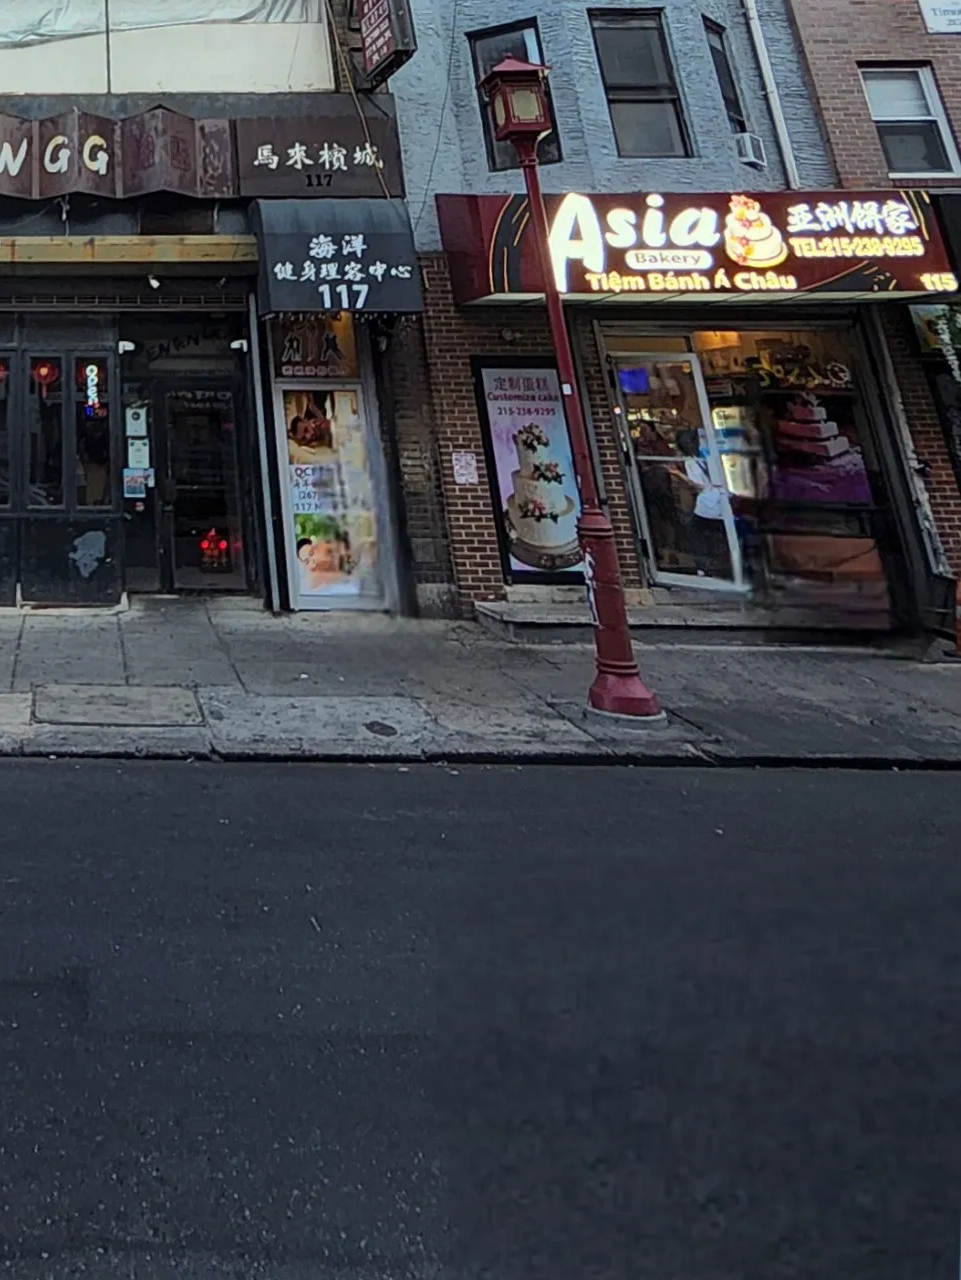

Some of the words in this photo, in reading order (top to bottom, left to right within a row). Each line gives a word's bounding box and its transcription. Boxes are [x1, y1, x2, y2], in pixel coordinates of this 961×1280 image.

[305, 174, 333, 188] 117
[309, 234, 368, 260] 海洋
[548, 193, 721, 292] Asia
[634, 251, 701, 267] Bakery
[273, 260, 412, 282] 健身理容中心
[585, 271, 646, 292] Tiệm
[649, 269, 711, 291] Bánh
[919, 271, 959, 292] 115
[317, 283, 369, 309] 117
